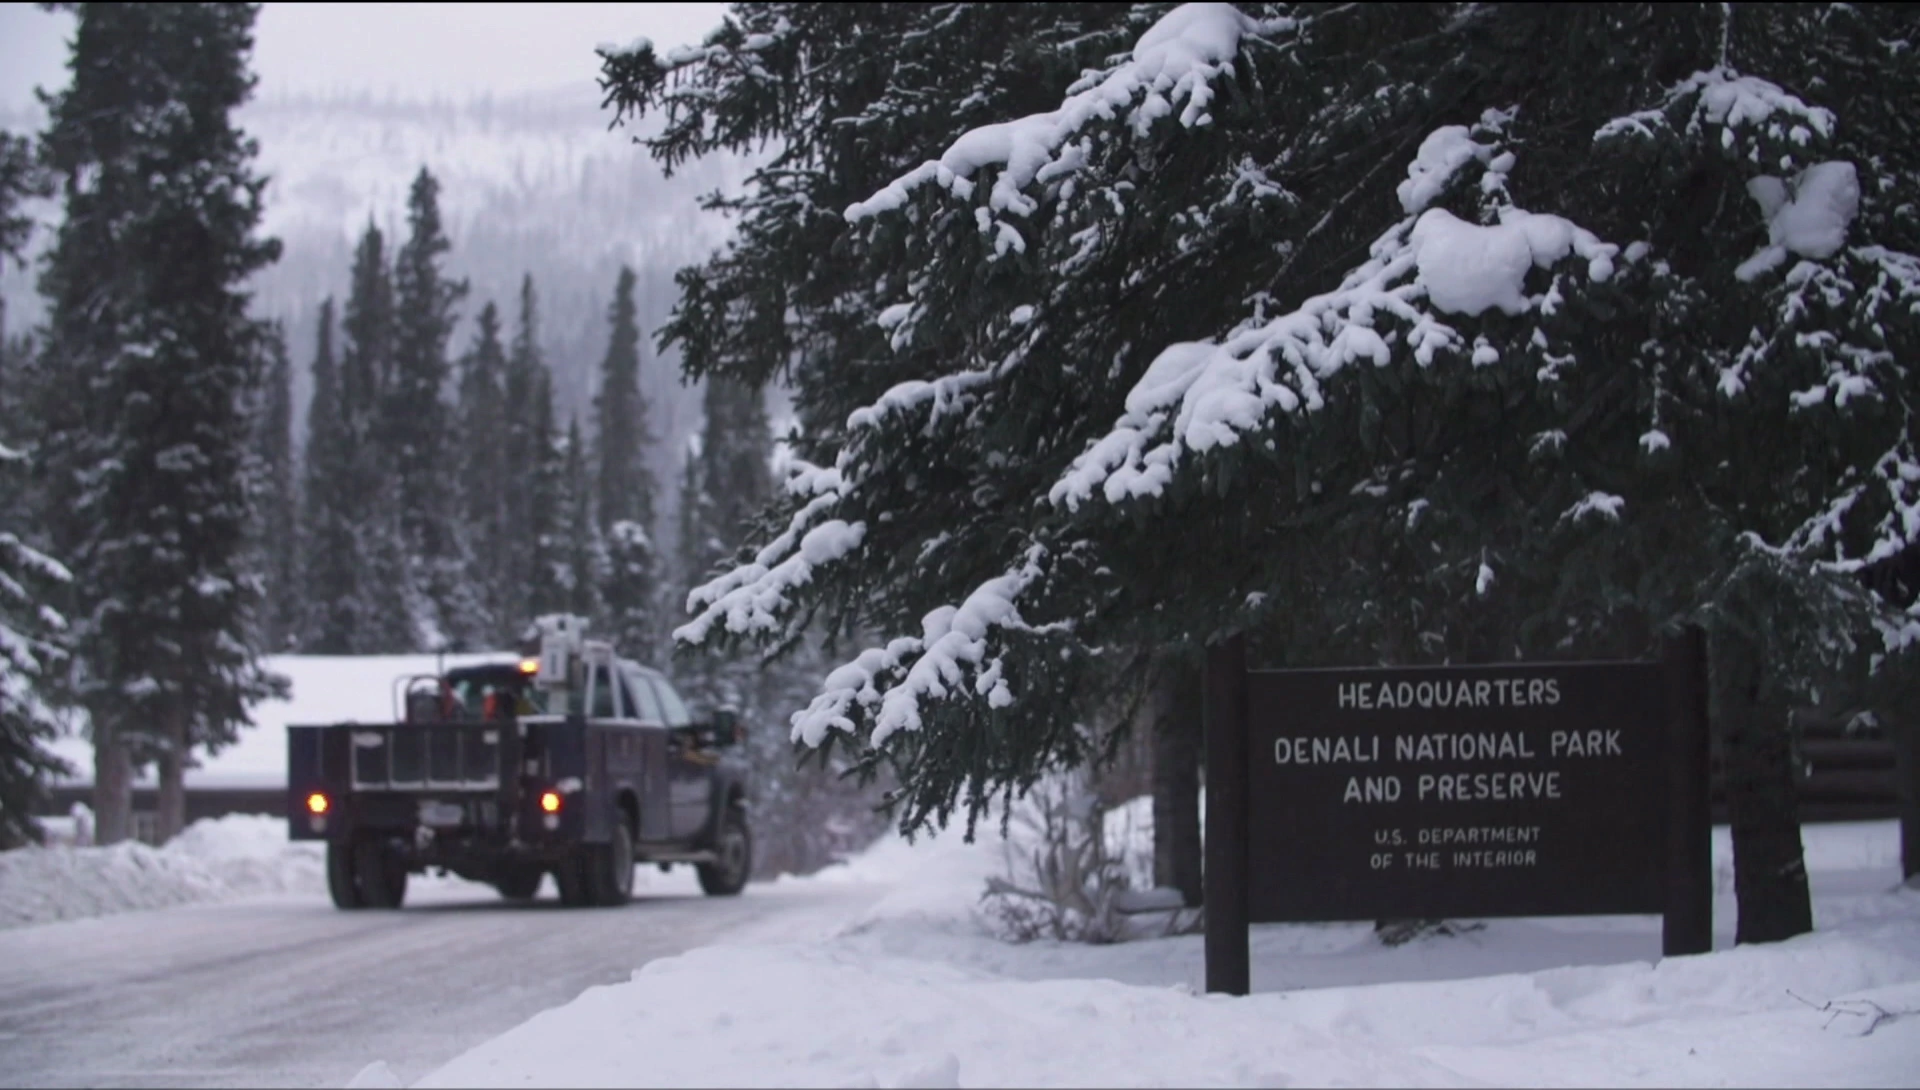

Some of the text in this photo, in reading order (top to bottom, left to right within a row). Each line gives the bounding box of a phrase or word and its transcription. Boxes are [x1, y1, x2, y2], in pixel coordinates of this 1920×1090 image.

[1338, 679, 1561, 708] HEADQUARTERS
[1275, 730, 1622, 763] DENALI NATIONAL PARK
[1344, 772, 1562, 803] AND PRESERVE
[1374, 826, 1541, 844] U.S. DEPARTMENT
[1370, 849, 1537, 869] OF THE INTERIOR
